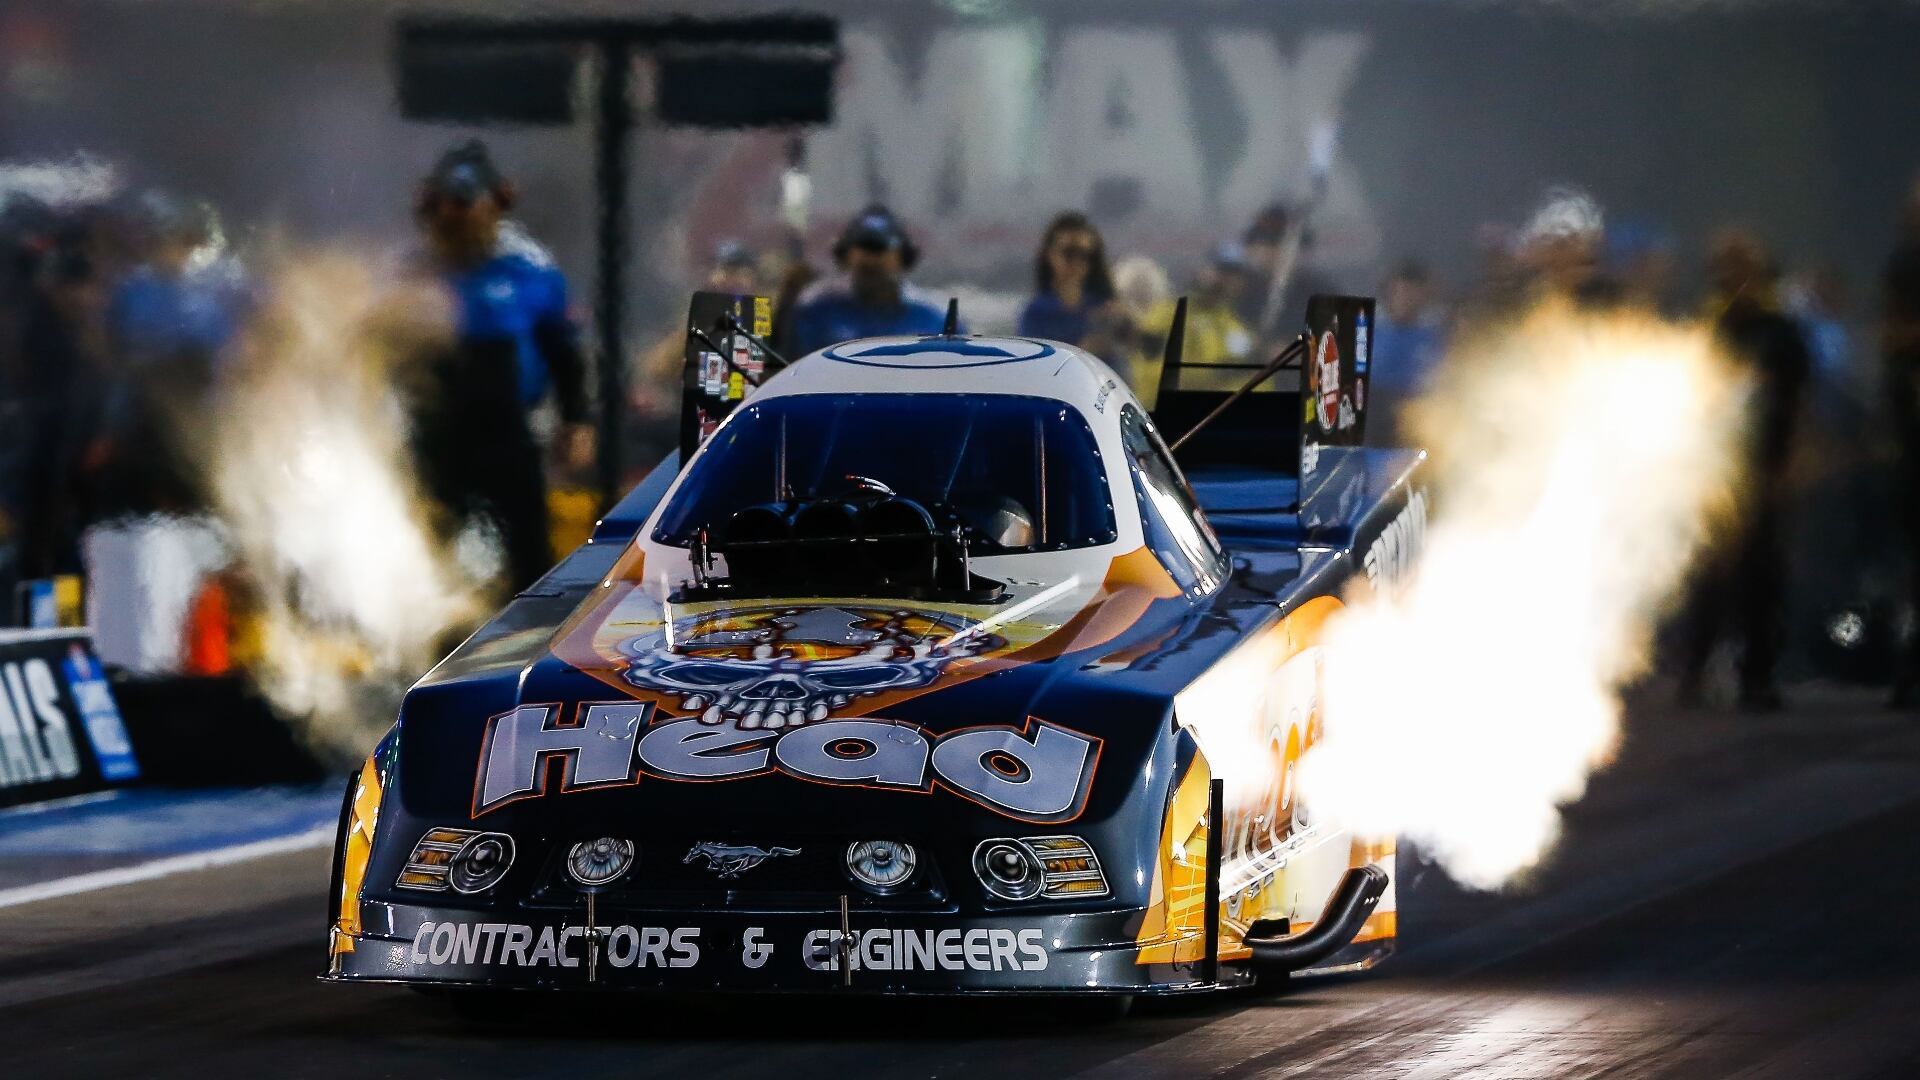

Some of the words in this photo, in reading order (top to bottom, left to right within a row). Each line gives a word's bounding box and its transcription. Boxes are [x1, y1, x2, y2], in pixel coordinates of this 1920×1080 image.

[798, 26, 1380, 252] MAX
[473, 701, 1102, 821] Head
[410, 922, 701, 968] CONTRACTORS
[742, 927, 774, 969] &
[802, 928, 1049, 971] ENGINEERS
